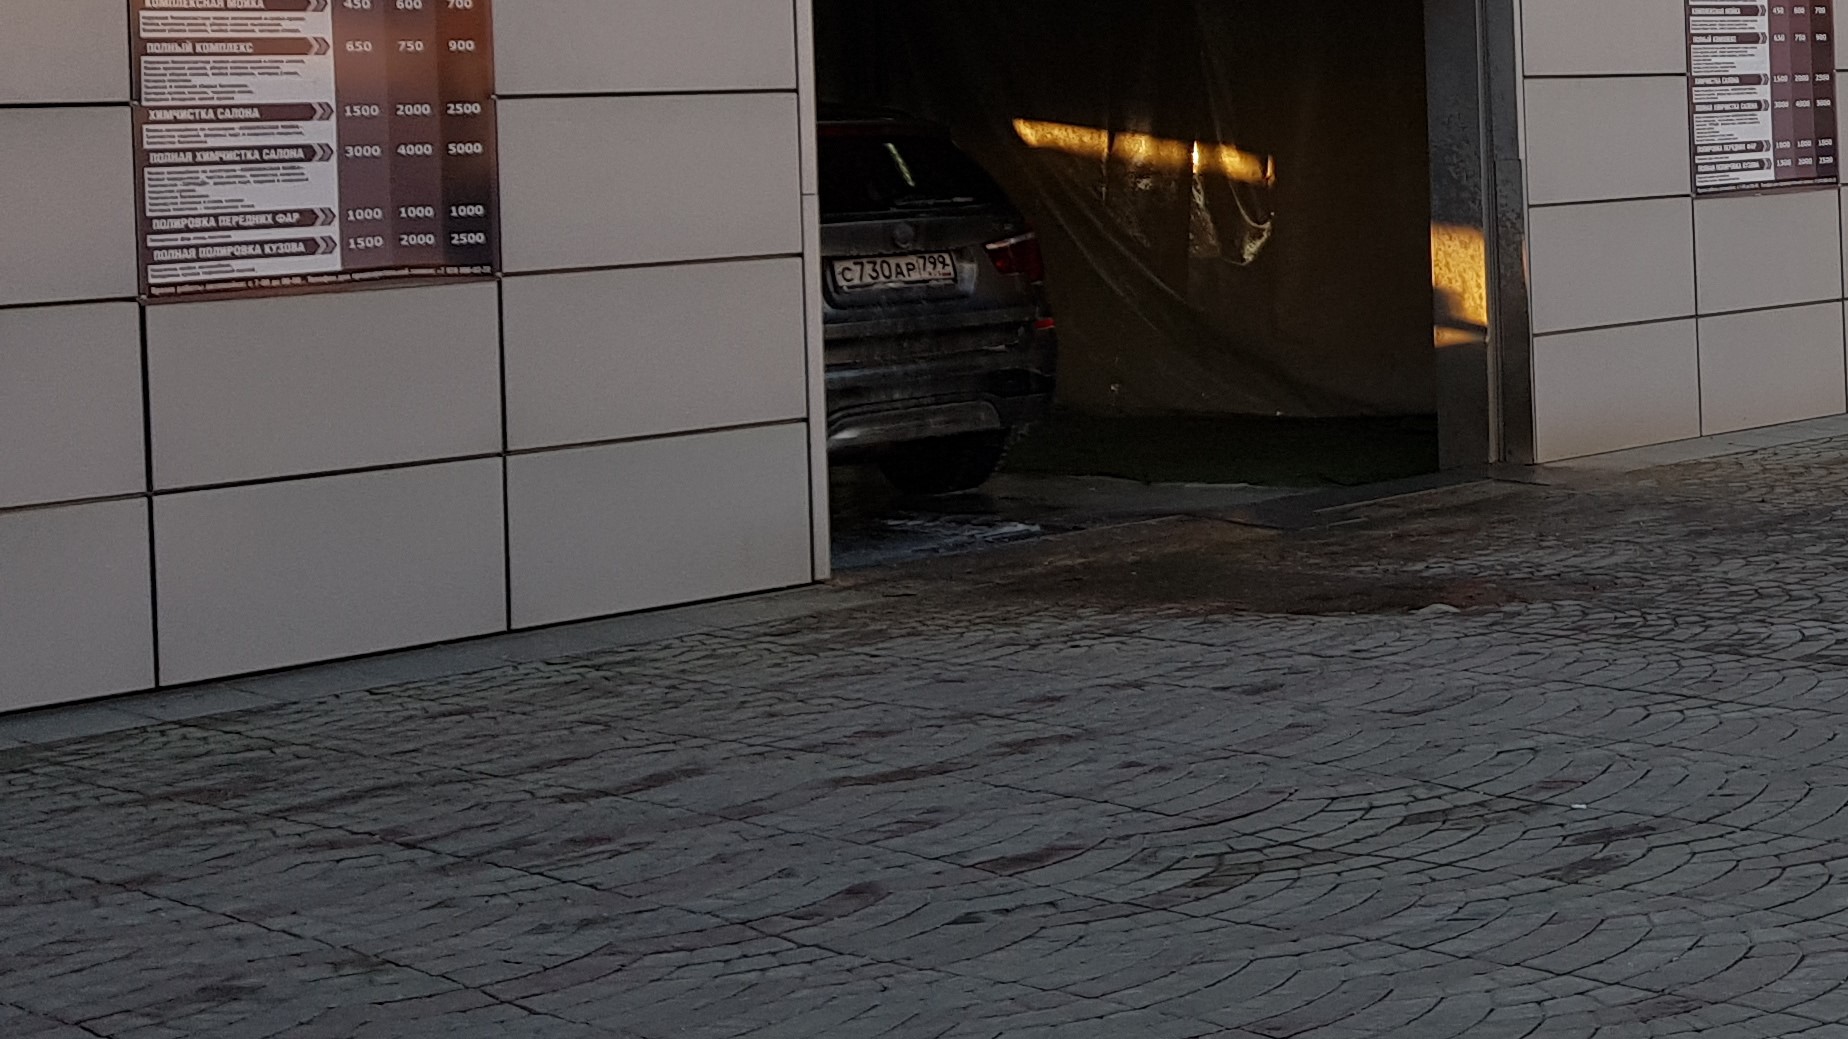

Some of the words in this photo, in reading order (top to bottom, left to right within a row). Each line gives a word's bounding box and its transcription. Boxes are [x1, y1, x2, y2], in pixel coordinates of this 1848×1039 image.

[146, 40, 194, 53] ПОЛНЫЙ
[195, 42, 253, 53] КОМПЛЕКС
[345, 41, 372, 52] 650
[397, 40, 424, 51] 750
[448, 40, 475, 51] 900
[149, 108, 216, 120] ХИМЧИСТКА
[217, 108, 261, 119] САЛОНА
[344, 105, 380, 117] 1500
[396, 104, 431, 115] 2000
[446, 103, 481, 115] 2500
[345, 145, 381, 157] 3000
[397, 144, 433, 156] 4000
[447, 143, 483, 154] 5000
[149, 151, 193, 164] ПОЛНАЯ
[195, 150, 262, 162] ХИМЧИСТКА
[262, 148, 305, 160] САЛОНА
[347, 208, 383, 221] 1000
[400, 206, 435, 218] 1000
[450, 205, 485, 217] 1000
[152, 217, 216, 230] ПОЛИРОВКА
[218, 214, 275, 227] ПЕРЕДНИХ
[275, 212, 300, 224] ФАР
[349, 236, 384, 249] 1500
[400, 234, 435, 246] 2000
[451, 232, 486, 244] 2500
[153, 247, 197, 261] ПОЛНАЯ
[199, 245, 262, 258] ПОЛИРОВКА
[263, 242, 307, 254] КУЗОВА
